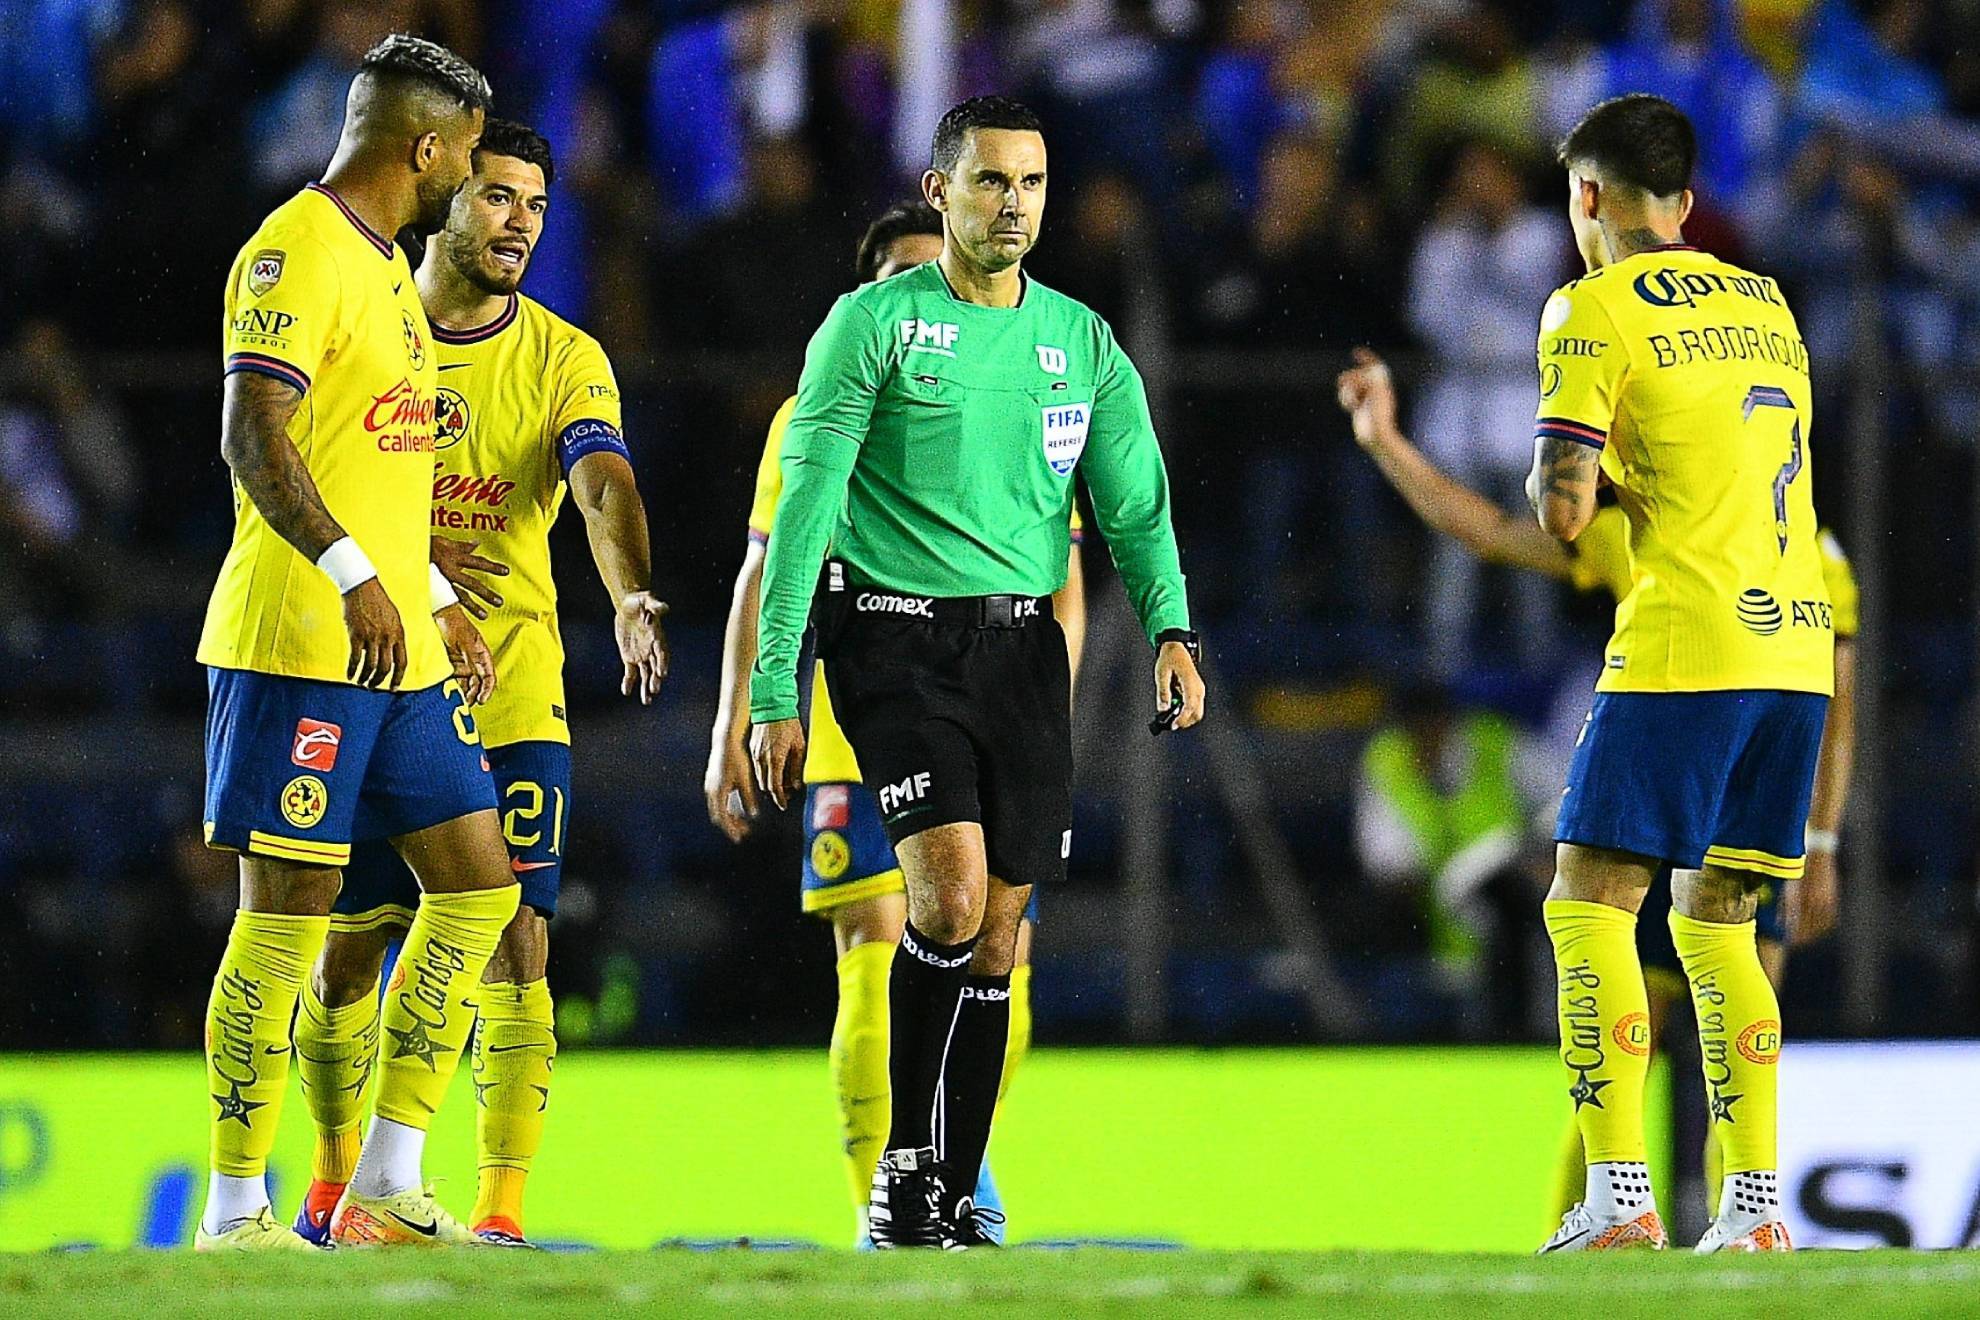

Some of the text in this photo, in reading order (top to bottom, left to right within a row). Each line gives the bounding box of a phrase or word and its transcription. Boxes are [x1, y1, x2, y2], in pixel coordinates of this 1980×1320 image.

[900, 317, 960, 349] FMF
[1047, 409, 1084, 428] FIFA
[563, 423, 603, 446] LIGA
[1741, 385, 1803, 557] 7
[431, 505, 508, 532] te.mx
[1792, 599, 1833, 629] AT&
[879, 771, 931, 815] FMF
[503, 781, 564, 856] 21
